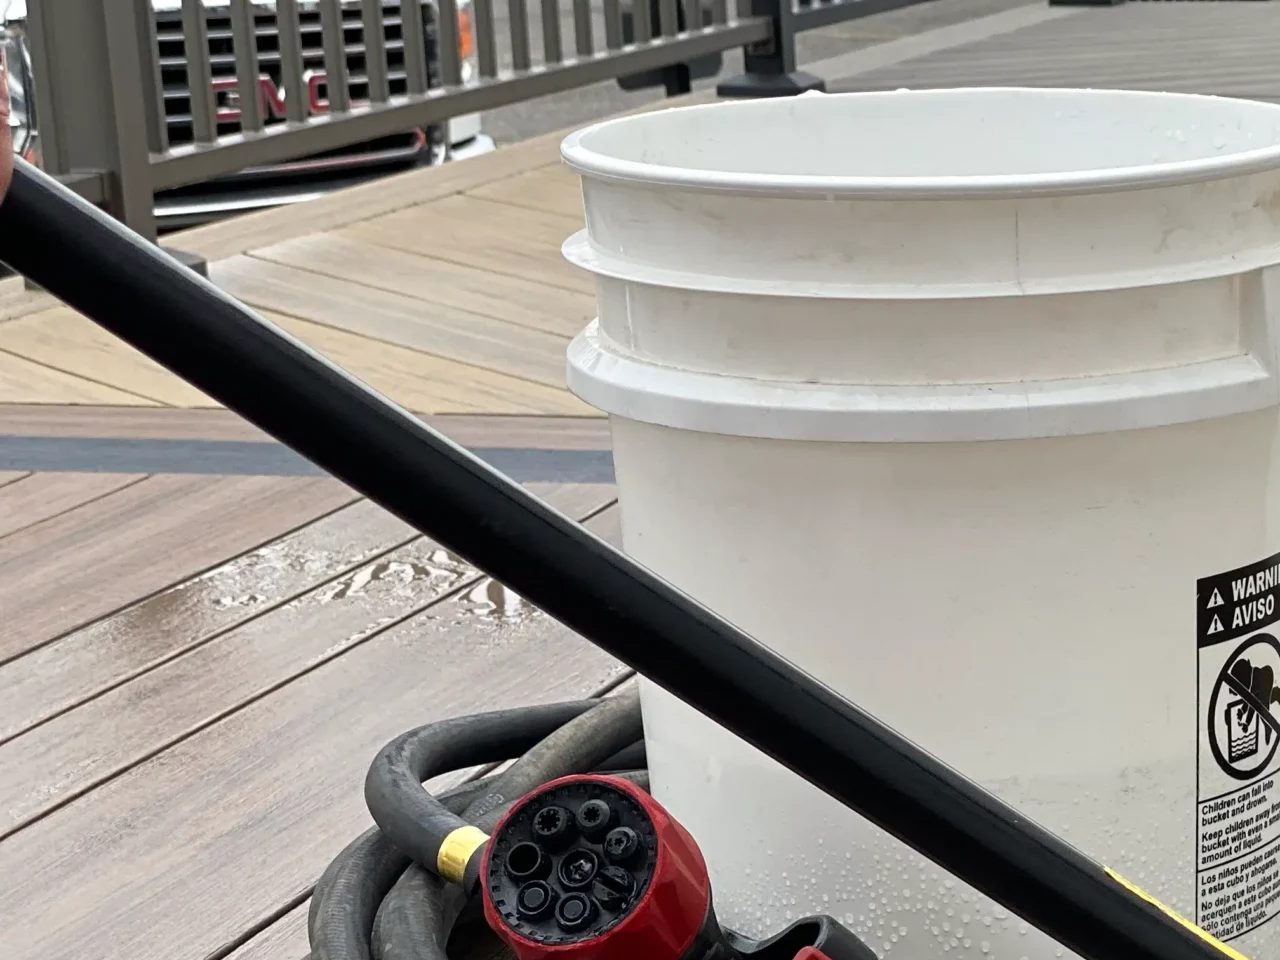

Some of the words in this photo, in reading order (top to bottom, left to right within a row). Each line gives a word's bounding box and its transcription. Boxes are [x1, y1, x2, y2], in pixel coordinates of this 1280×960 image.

[1231, 594, 1275, 629] AVISO
[1202, 798, 1236, 815] Children
[1238, 791, 1250, 803] can
[1252, 784, 1261, 797] fall
[1263, 780, 1274, 792] into
[1202, 810, 1229, 826] bucket
[1231, 803, 1245, 817] and
[1246, 795, 1267, 810] drown.
[1202, 829, 1223, 842] Keep
[1225, 817, 1254, 834] children
[1255, 808, 1270, 822] away
[1202, 837, 1229, 853] bucket
[1231, 830, 1246, 843] with
[1248, 823, 1263, 836] even
[1264, 820, 1268, 828] a
[1202, 846, 1232, 864] amount
[1234, 841, 1242, 853] of
[1243, 832, 1262, 849] liquid.
[1202, 874, 1216, 885] Los
[1218, 866, 1238, 880] niños
[1240, 855, 1263, 874] pueden
[1208, 883, 1224, 894] esta
[1226, 876, 1244, 888] cubo
[1245, 872, 1249, 882] y
[1201, 904, 1236, 922] acerquen
[1238, 901, 1242, 909] a
[1258, 885, 1271, 899] cubo
[1202, 901, 1212, 911] No
[1215, 894, 1230, 906] deja
[1232, 889, 1245, 901] que
[1246, 884, 1255, 894] los
[1201, 921, 1218, 931] sólo
[1221, 908, 1252, 926] contenga
[1254, 901, 1264, 912] una
[1236, 922, 1244, 931] de
